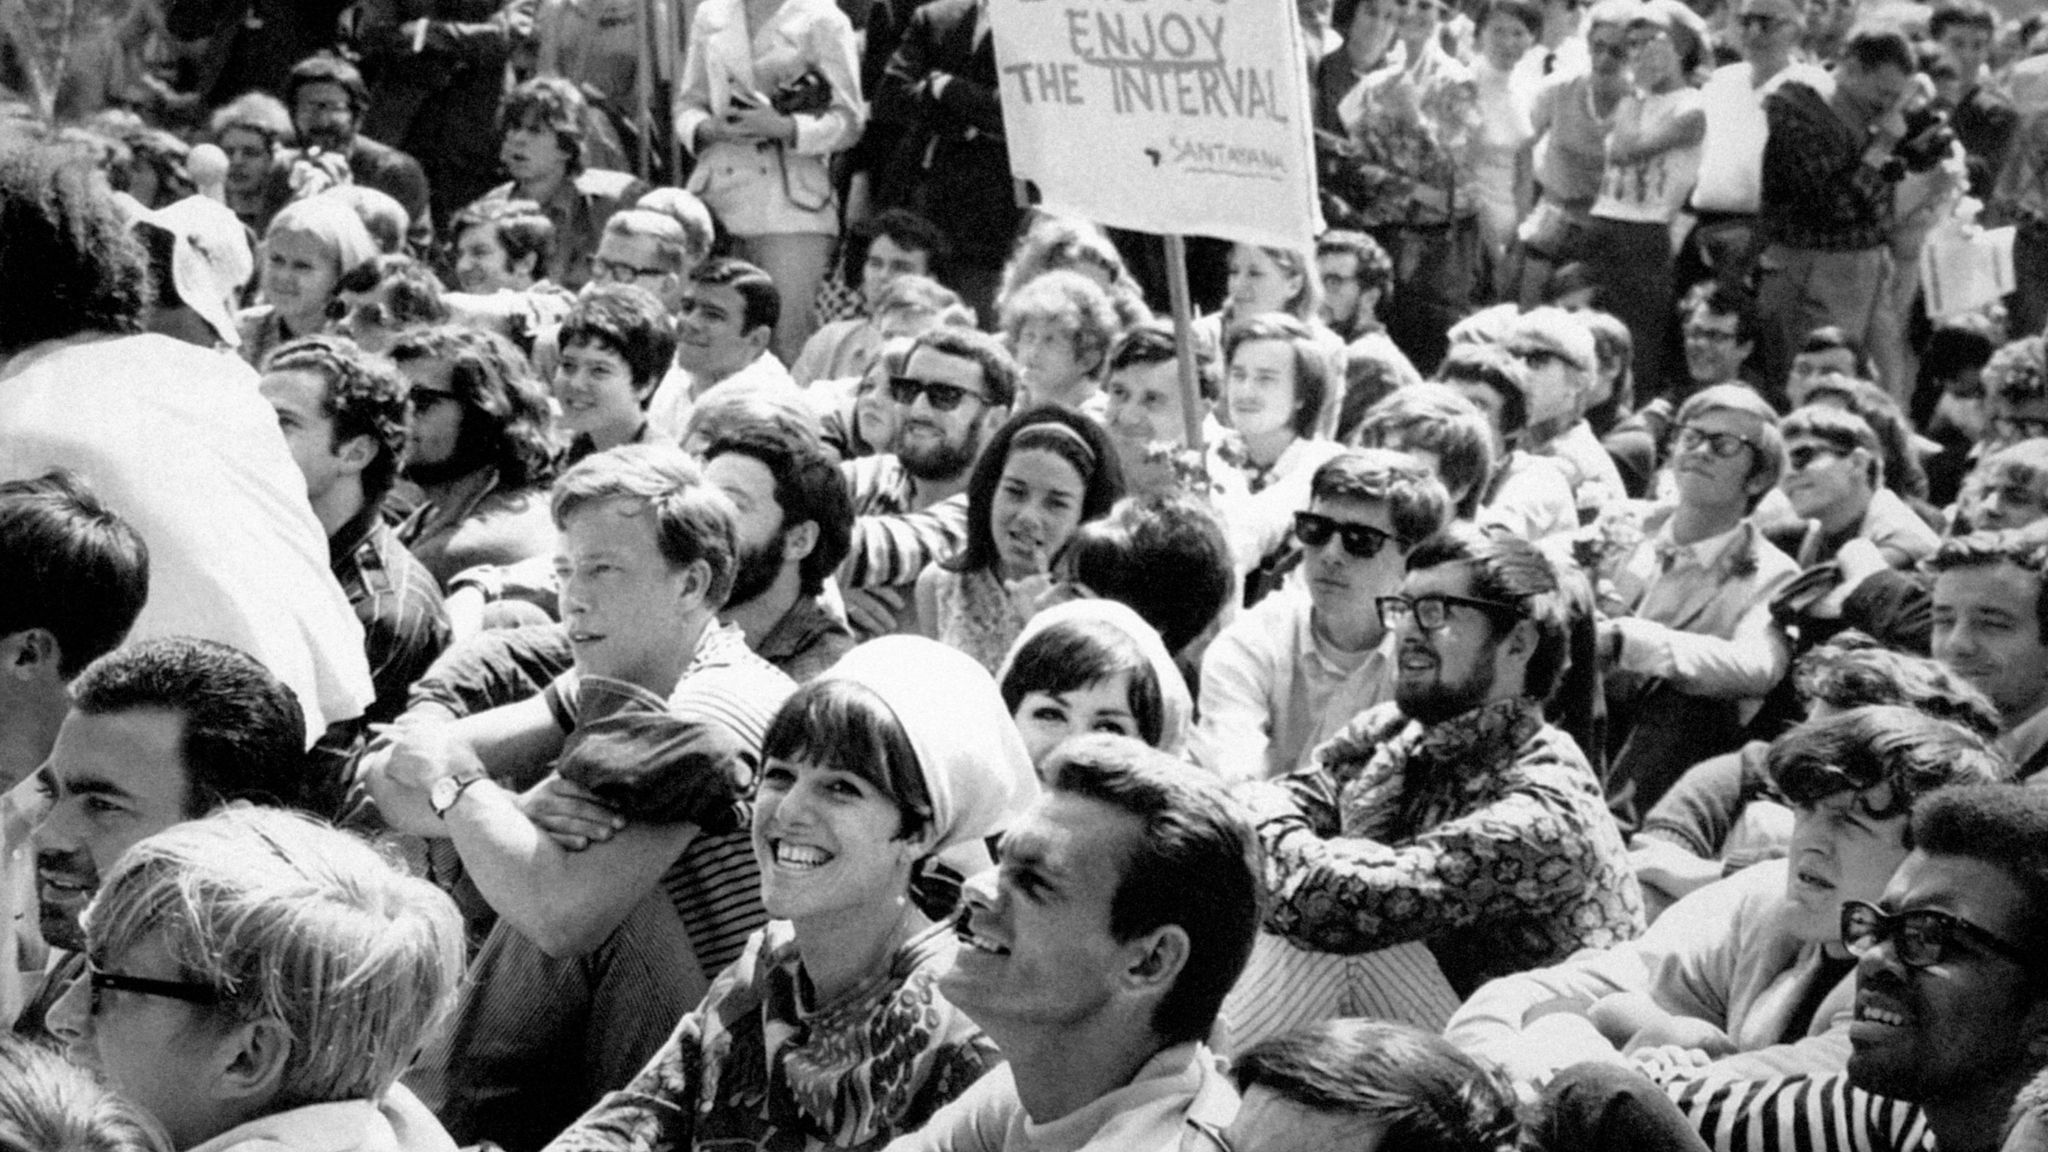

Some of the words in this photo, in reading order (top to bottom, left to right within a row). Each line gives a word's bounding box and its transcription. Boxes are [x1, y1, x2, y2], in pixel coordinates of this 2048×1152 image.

[1065, 8, 1224, 63] ENJOY
[1003, 61, 1085, 105] THE
[1110, 66, 1289, 123] INTERVAL
